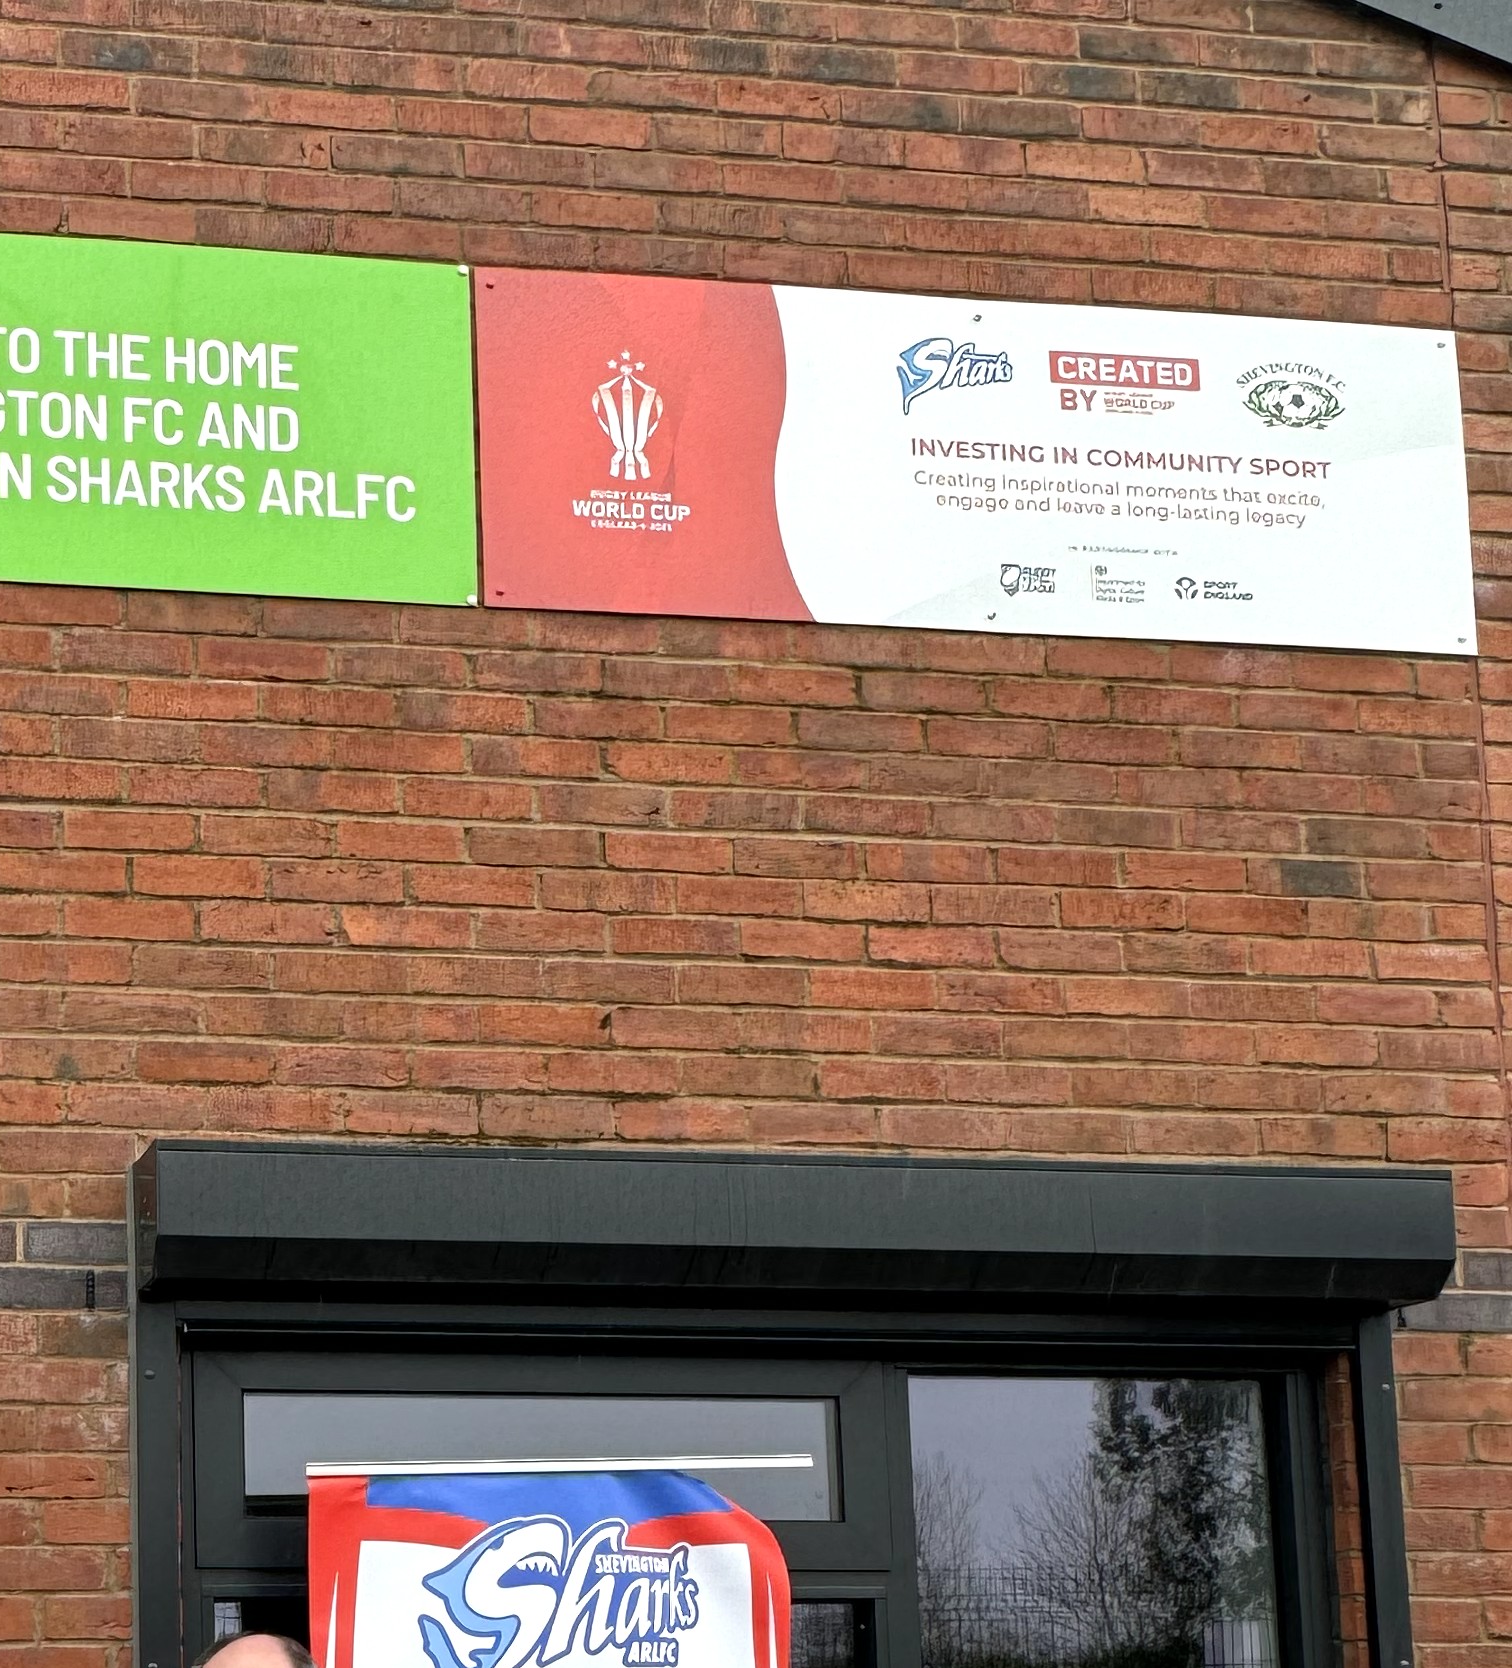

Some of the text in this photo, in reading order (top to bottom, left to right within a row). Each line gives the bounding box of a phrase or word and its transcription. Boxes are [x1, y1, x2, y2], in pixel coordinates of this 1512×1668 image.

[53, 329, 152, 381] THE
[165, 336, 300, 391] HOME
[1057, 356, 1193, 386] CREATED
[1060, 388, 1097, 411] BY
[123, 396, 184, 446] FC
[197, 401, 300, 453] AND
[911, 437, 1332, 480] INVESTING IN COMMUNITY SPORT
[46, 454, 246, 513] SHARKS
[258, 468, 417, 523] ARLFC
[914, 470, 996, 492] Creating
[1002, 474, 1119, 495] inspirational
[1126, 485, 1218, 501] moments
[1223, 487, 1262, 503] that
[572, 499, 691, 522] WORLD CUP
[1015, 497, 1050, 511] and
[1127, 501, 1239, 525] long-lasting
[595, 1553, 671, 1574] SHEVINGTON
[627, 1640, 677, 1664] ARLFC
